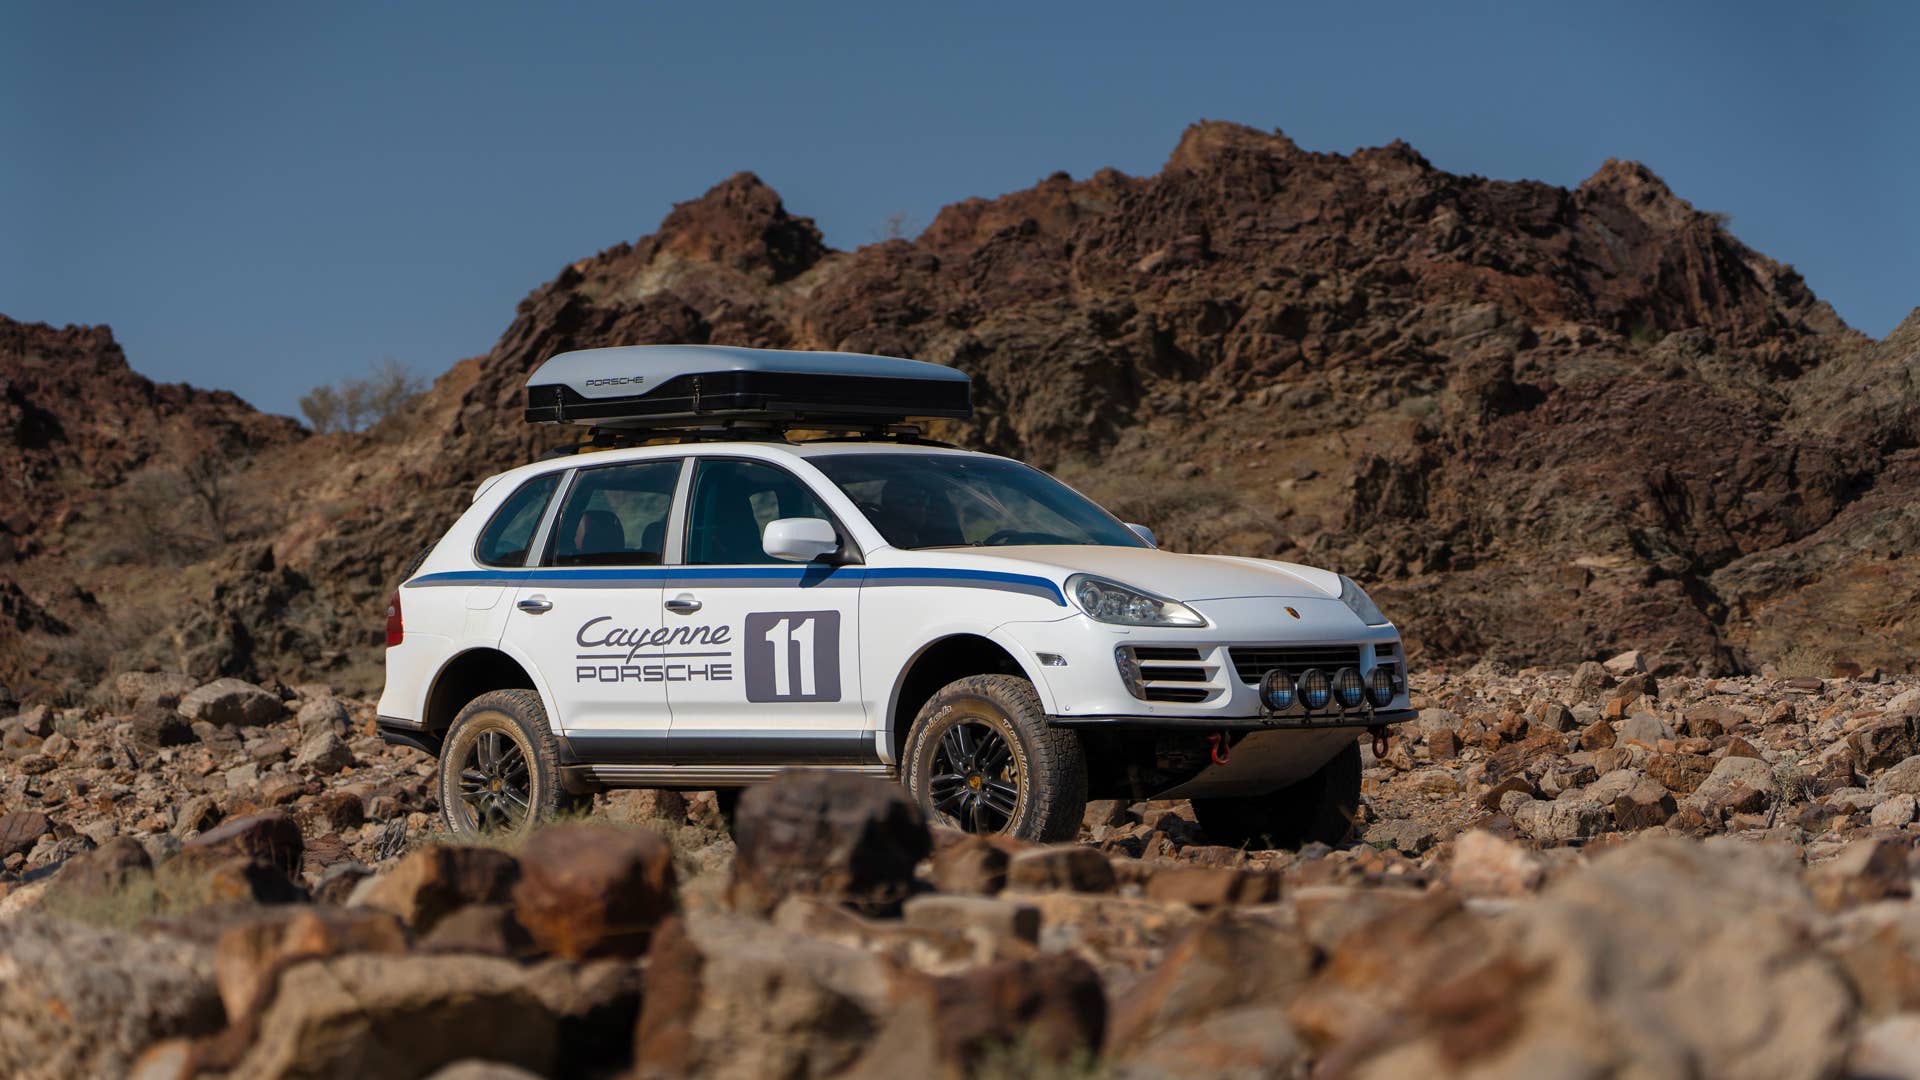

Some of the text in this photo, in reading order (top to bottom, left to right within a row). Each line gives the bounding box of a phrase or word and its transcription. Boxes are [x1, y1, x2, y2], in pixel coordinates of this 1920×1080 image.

[585, 376, 644, 387] PORSCHE
[576, 615, 732, 664] Cayenne
[576, 664, 732, 683] PORSCHE
[765, 618, 816, 696] 11
